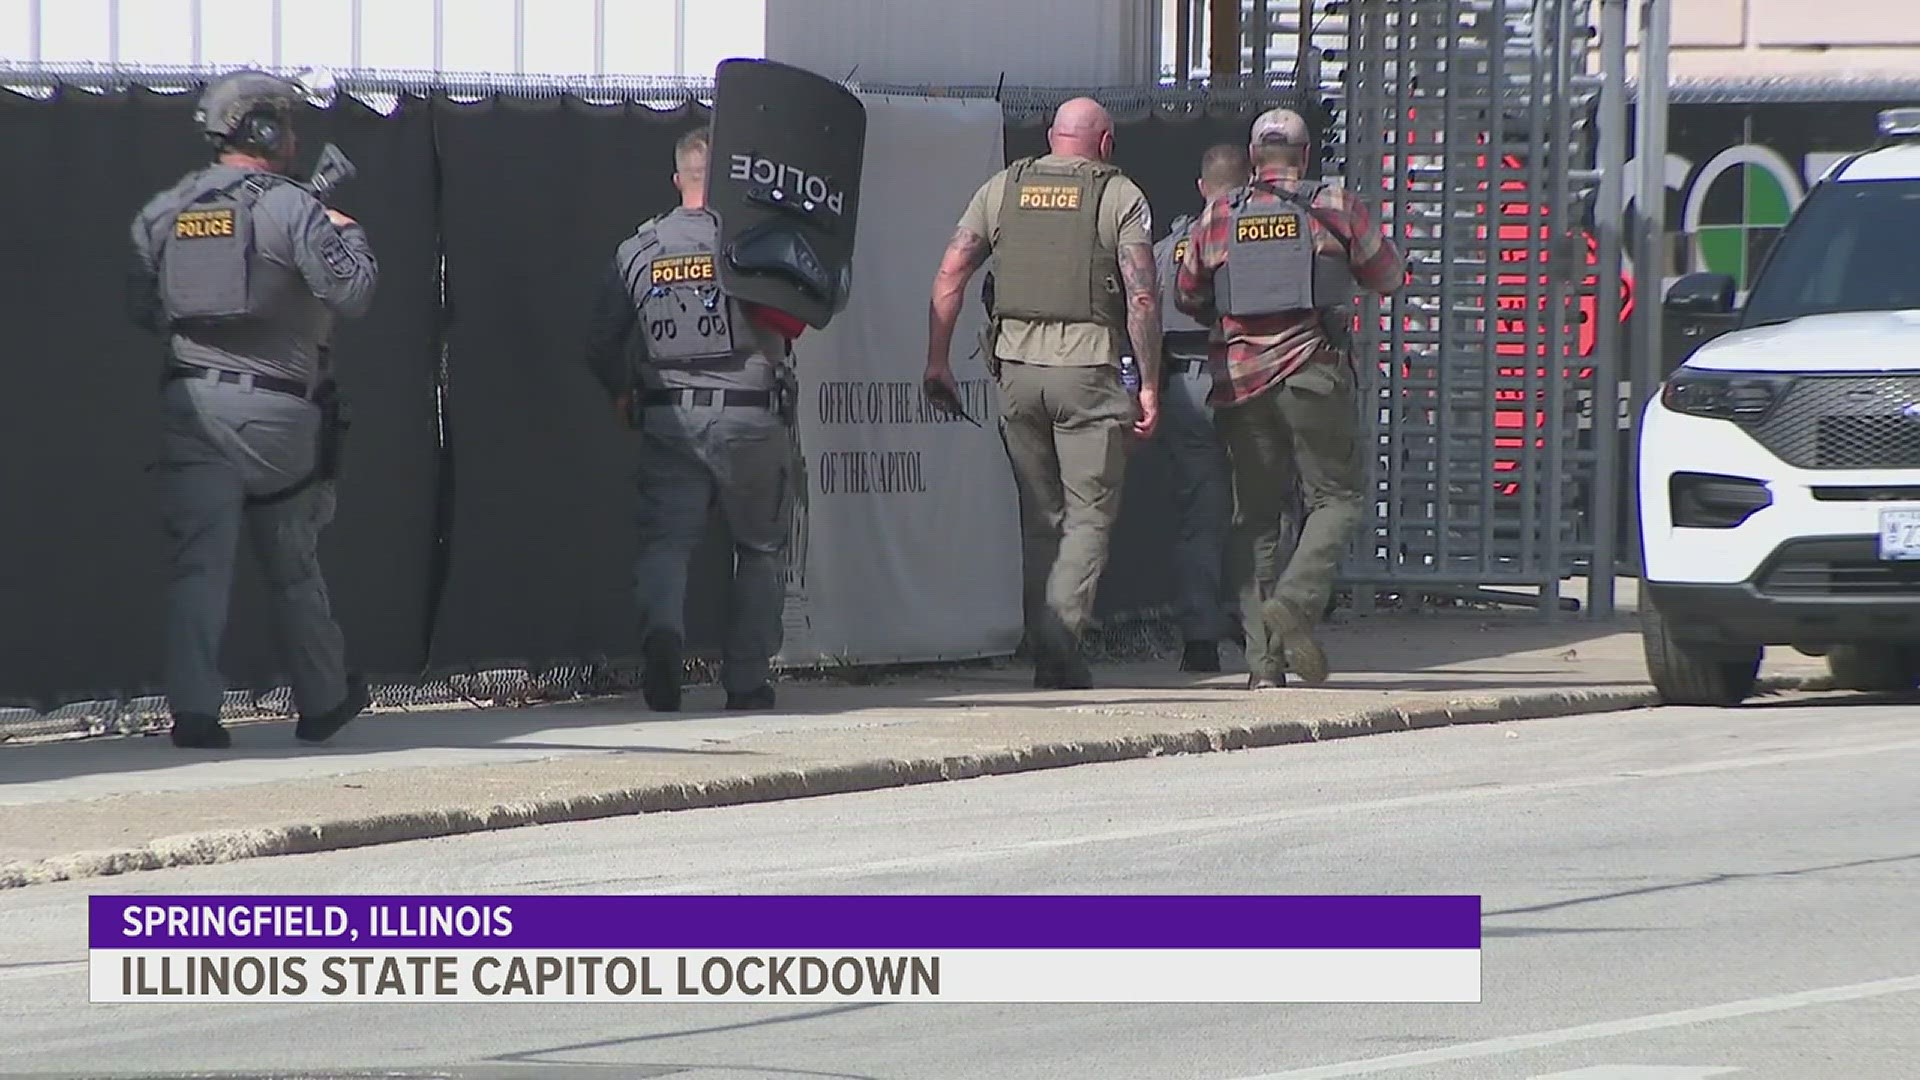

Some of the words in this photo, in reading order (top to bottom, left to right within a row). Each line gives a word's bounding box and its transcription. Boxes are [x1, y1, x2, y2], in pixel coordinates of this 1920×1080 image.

[730, 154, 843, 215] POLICE
[1020, 193, 1079, 208] POLICE
[177, 219, 233, 239] POLICE
[1238, 223, 1297, 241] POLICE
[652, 263, 713, 283] POLICE
[818, 381, 864, 424] OFFICE
[867, 381, 885, 424] OF
[886, 381, 913, 424] THE
[820, 451, 839, 494] OF
[840, 451, 870, 493] THE
[869, 451, 927, 493] CAPITOL
